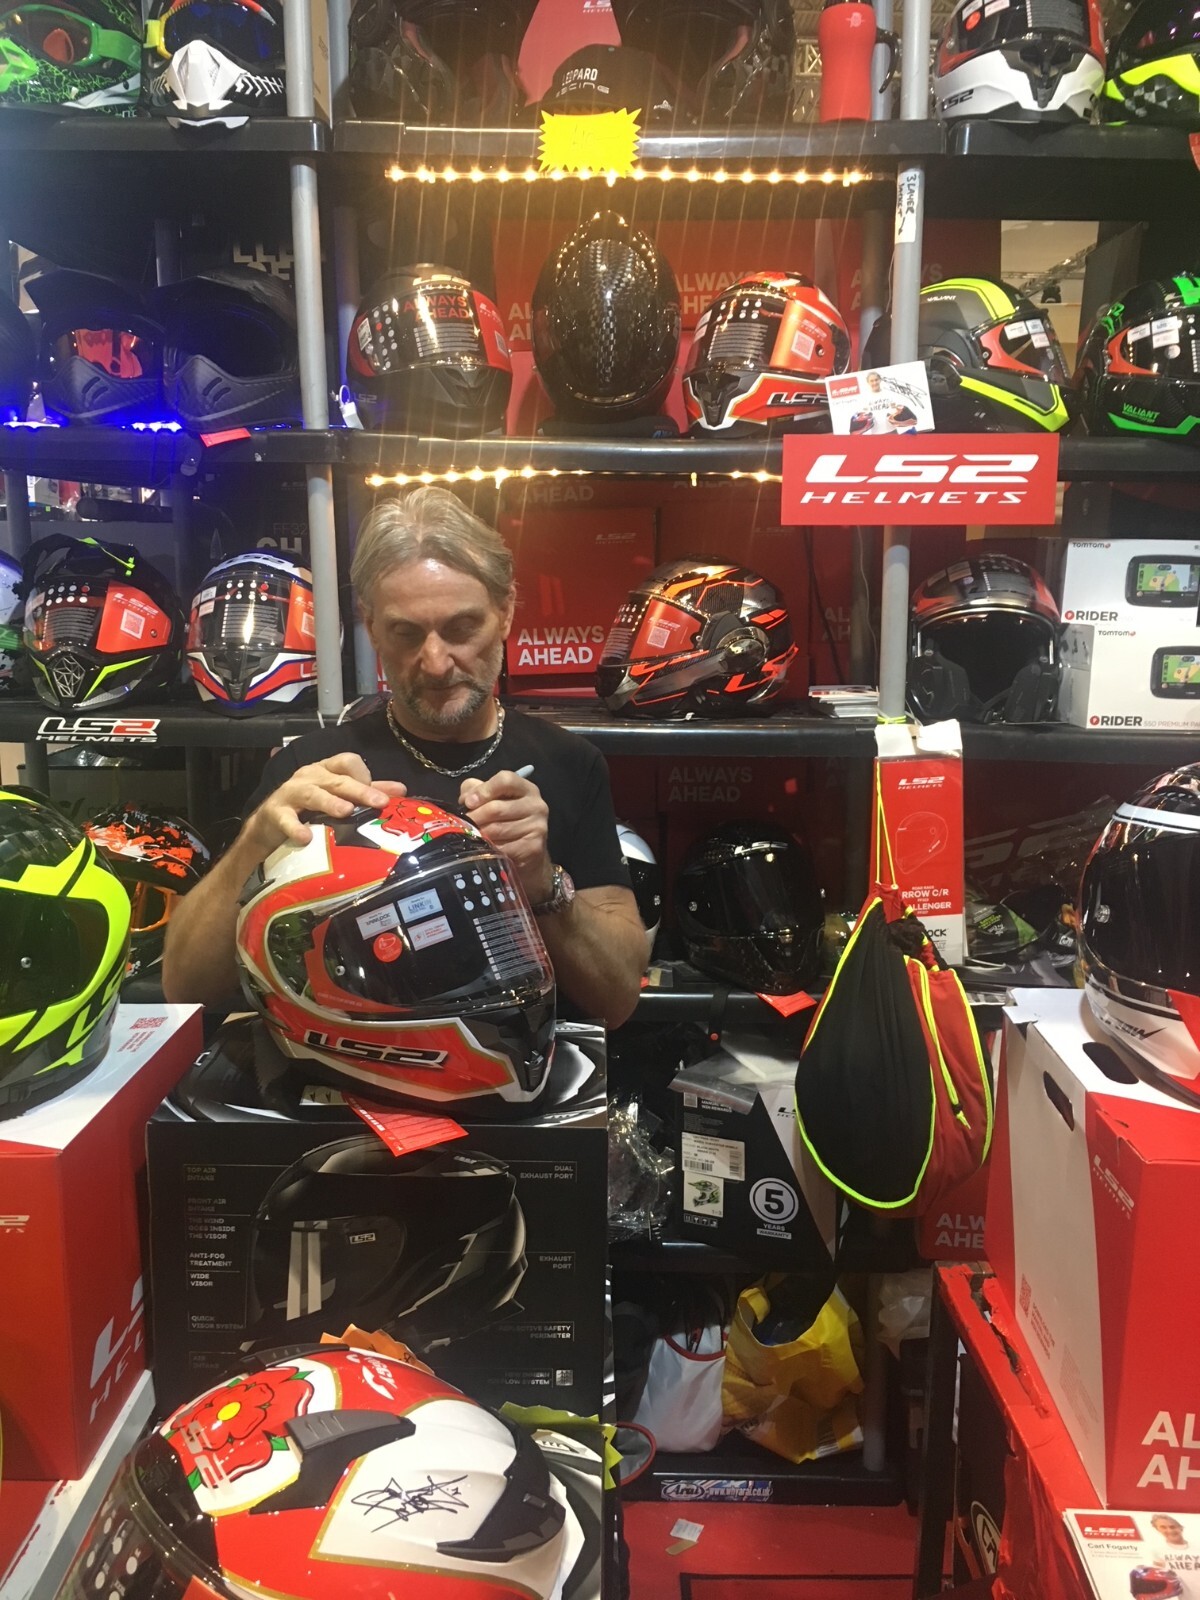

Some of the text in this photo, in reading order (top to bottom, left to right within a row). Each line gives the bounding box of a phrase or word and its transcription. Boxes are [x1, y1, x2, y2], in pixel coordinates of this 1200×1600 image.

[562, 67, 599, 86] LEOPARD
[1122, 402, 1161, 419] VALIANT
[805, 454, 1039, 483] LS2
[800, 491, 1028, 504] HELMETS
[1075, 610, 1118, 621] RIDER
[517, 625, 605, 646] ALWAYS
[518, 647, 594, 666] AHEAD
[37, 716, 161, 736] LS2
[1100, 715, 1143, 726] RIDER
[35, 735, 158, 743] HELMETS
[668, 766, 753, 783] ALWAYS
[898, 775, 945, 786] LS2
[668, 785, 741, 802] AHEAD
[901, 888, 949, 899] RROW C/R
[908, 901, 952, 911] ALLENGER
[304, 1028, 448, 1069] LS2
[1093, 1154, 1135, 1210] LS2
[764, 1188, 785, 1215] 5
[763, 1223, 786, 1232] YEARS
[349, 1232, 376, 1244] LS2
[189, 1252, 226, 1260] ANTI-FOG
[669, 1484, 699, 1495] Arai
[1084, 1526, 1136, 1534] LS2
[1106, 1543, 1138, 1552] Fogarty
